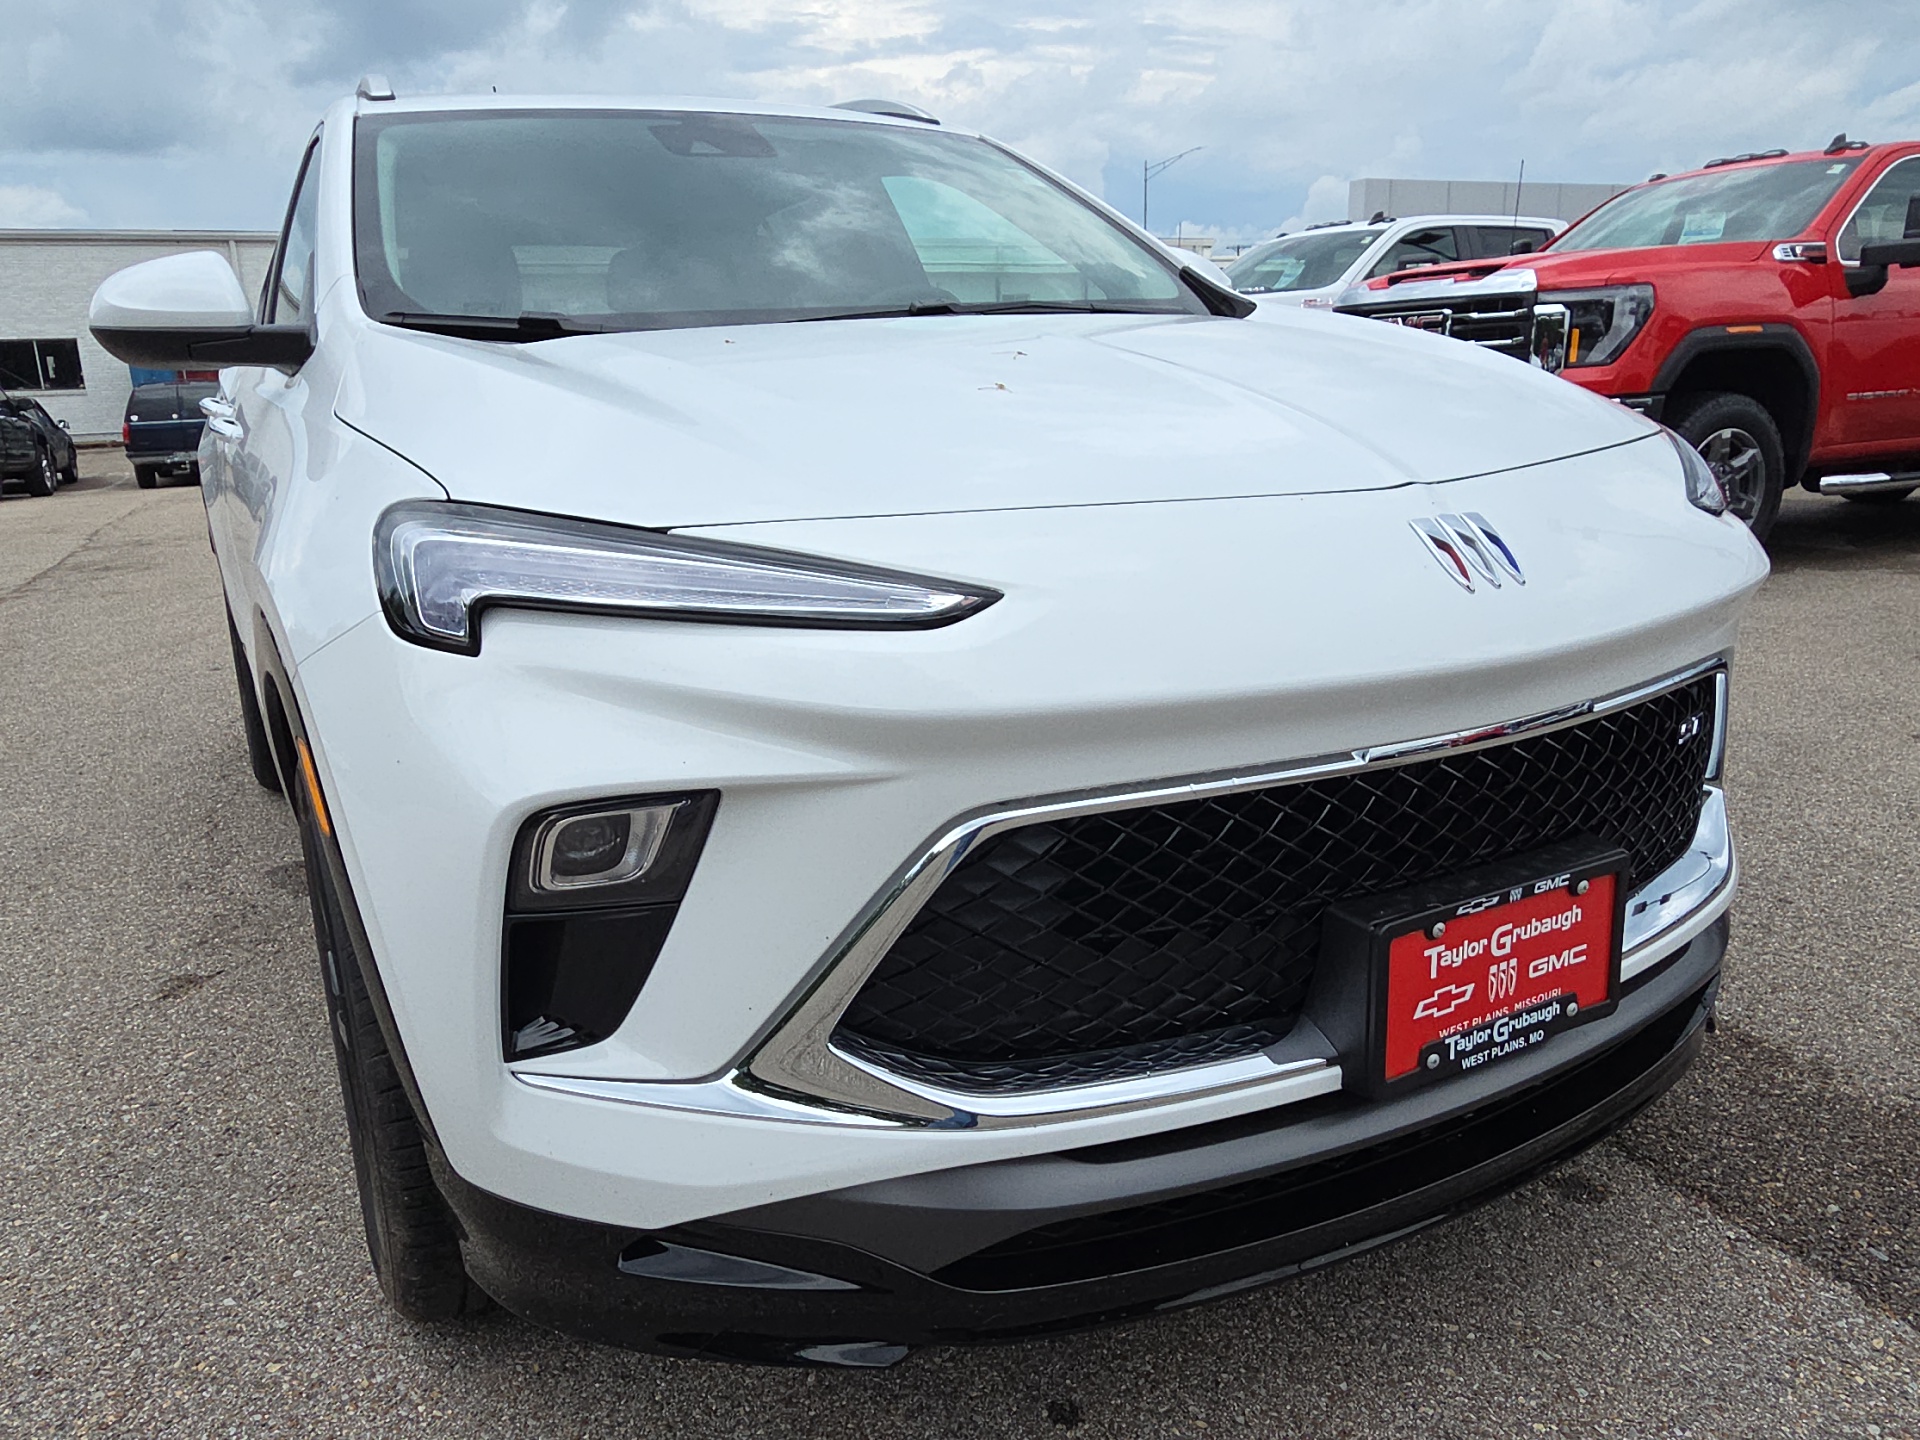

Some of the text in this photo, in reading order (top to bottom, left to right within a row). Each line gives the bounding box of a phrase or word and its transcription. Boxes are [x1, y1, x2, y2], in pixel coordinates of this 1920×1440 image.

[1534, 873, 1571, 894] GMC
[1423, 904, 1582, 980] Taylor Grubaugh
[1528, 943, 1588, 979] GMC
[1438, 1020, 1470, 1038] WEST
[1514, 987, 1562, 1012] MISSOURI
[1444, 1001, 1560, 1060] Taylor Grubaugh
[1461, 1049, 1490, 1070] WEST
[1528, 1029, 1545, 1044] MO
